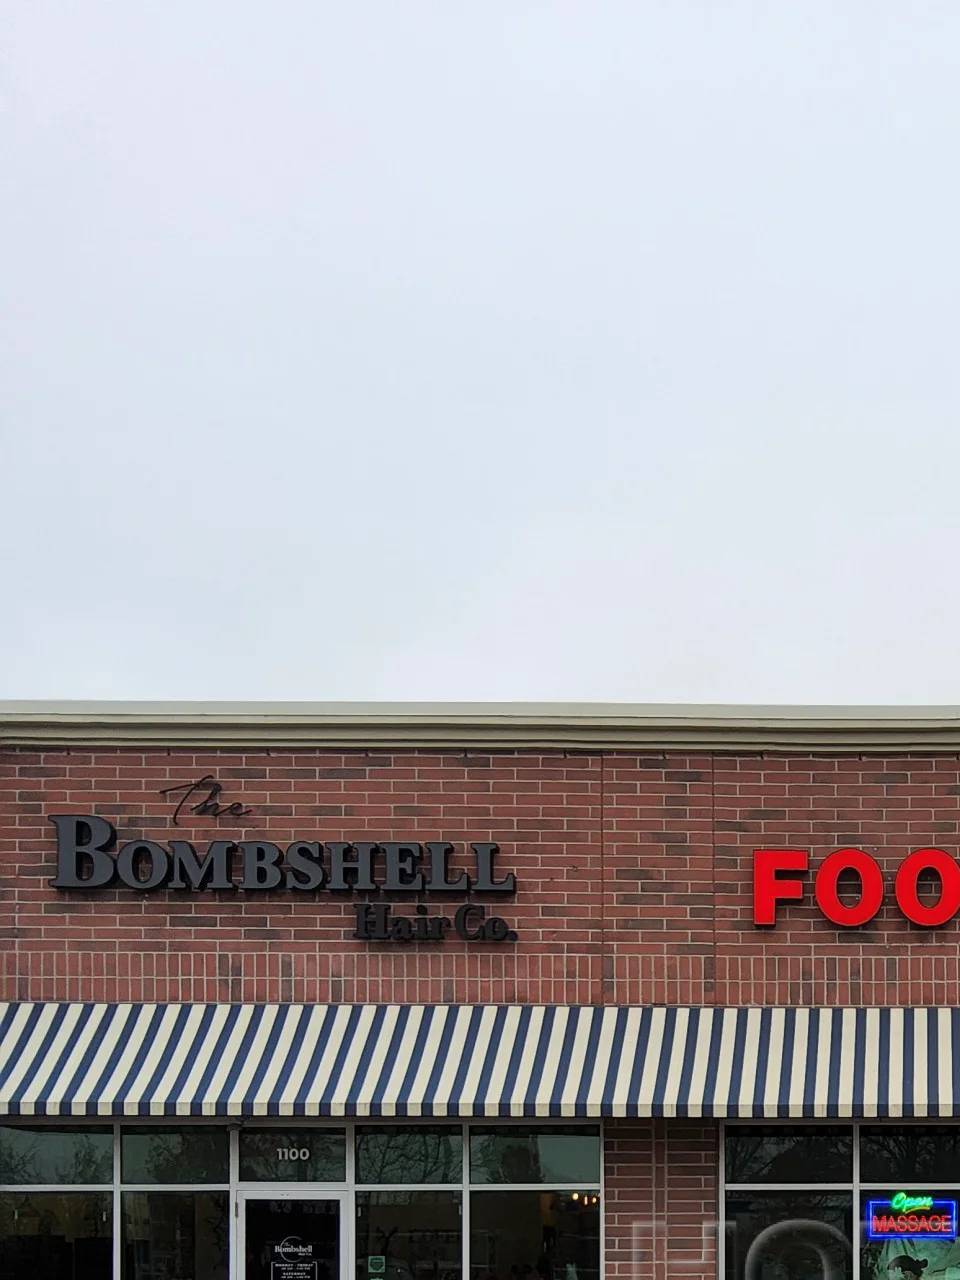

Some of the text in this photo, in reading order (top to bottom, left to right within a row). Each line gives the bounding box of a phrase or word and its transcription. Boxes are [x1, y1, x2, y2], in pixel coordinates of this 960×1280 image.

[159, 775, 252, 825] The
[48, 814, 517, 893] BOMBSHELL
[353, 903, 518, 942] Hair Co.
[276, 1147, 310, 1160] 1100
[891, 1191, 933, 1212] Open
[872, 1214, 952, 1232] MASSAGE
[274, 1245, 312, 1253] Bombshell
